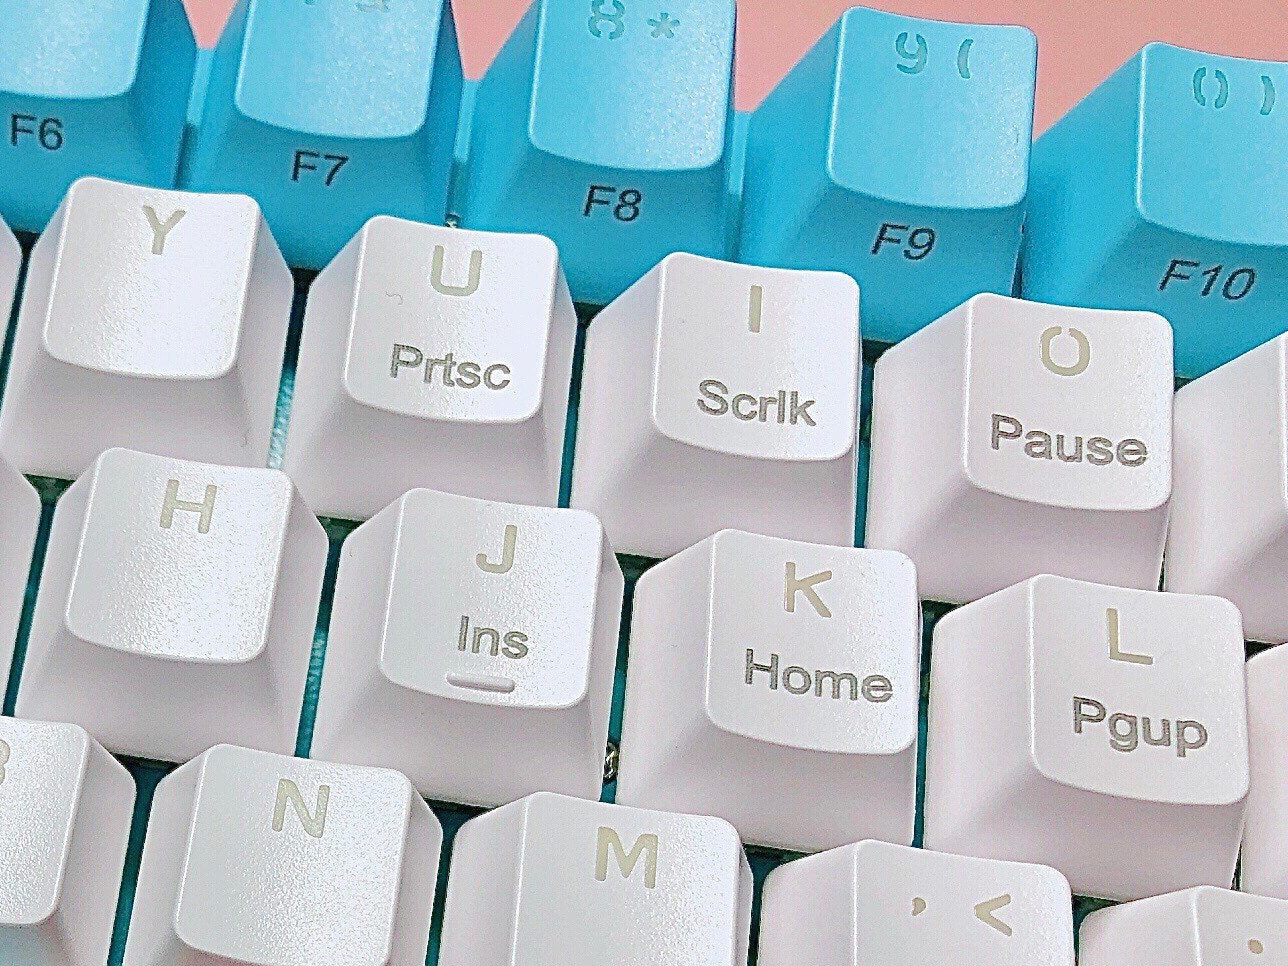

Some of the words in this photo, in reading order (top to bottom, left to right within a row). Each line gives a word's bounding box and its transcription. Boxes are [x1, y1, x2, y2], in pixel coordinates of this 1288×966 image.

[895, 32, 928, 74] 9
[10, 114, 64, 150] F6
[290, 150, 349, 187] F7
[582, 185, 642, 222] F8
[142, 206, 186, 256] Y
[872, 222, 936, 261] F9
[430, 245, 483, 297] U
[1158, 259, 1256, 300] F10
[390, 343, 511, 391] Prtsc
[696, 379, 816, 427] Scrlk
[990, 412, 1148, 468] Pause
[159, 479, 218, 534] H
[475, 524, 518, 574] J
[784, 561, 833, 618] K
[457, 614, 530, 660] Ins
[1106, 608, 1154, 665] L
[744, 648, 894, 704] Home
[1072, 696, 1208, 757] Pgup
[271, 778, 330, 838] N
[594, 826, 659, 889] M
